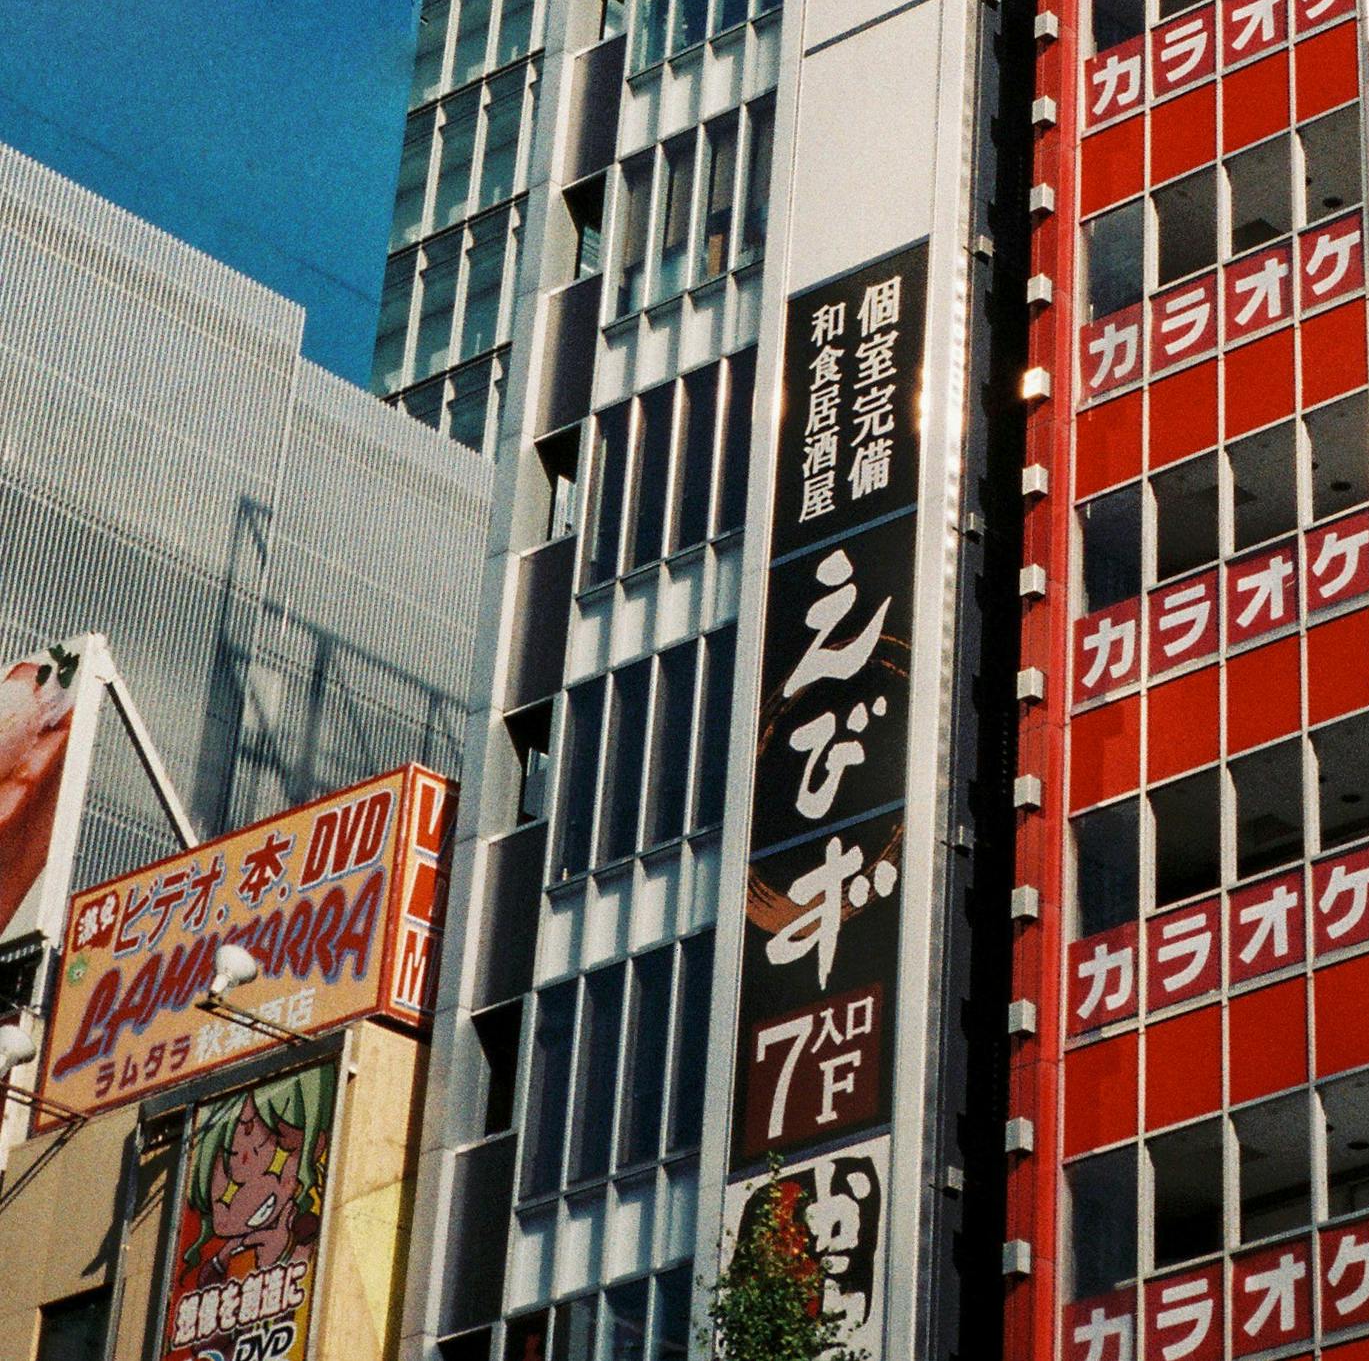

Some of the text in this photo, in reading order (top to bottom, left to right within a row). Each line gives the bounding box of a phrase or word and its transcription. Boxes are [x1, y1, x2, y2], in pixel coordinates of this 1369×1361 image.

[1089, 229, 1362, 389] カラオケ
[798, 301, 847, 524] 和食居酒屋
[847, 275, 902, 502] 個室完備
[297, 788, 396, 893] DVD
[95, 1034, 192, 1099] ラムタラ
[811, 995, 874, 1054] 入口
[235, 1324, 295, 1361] DVD
